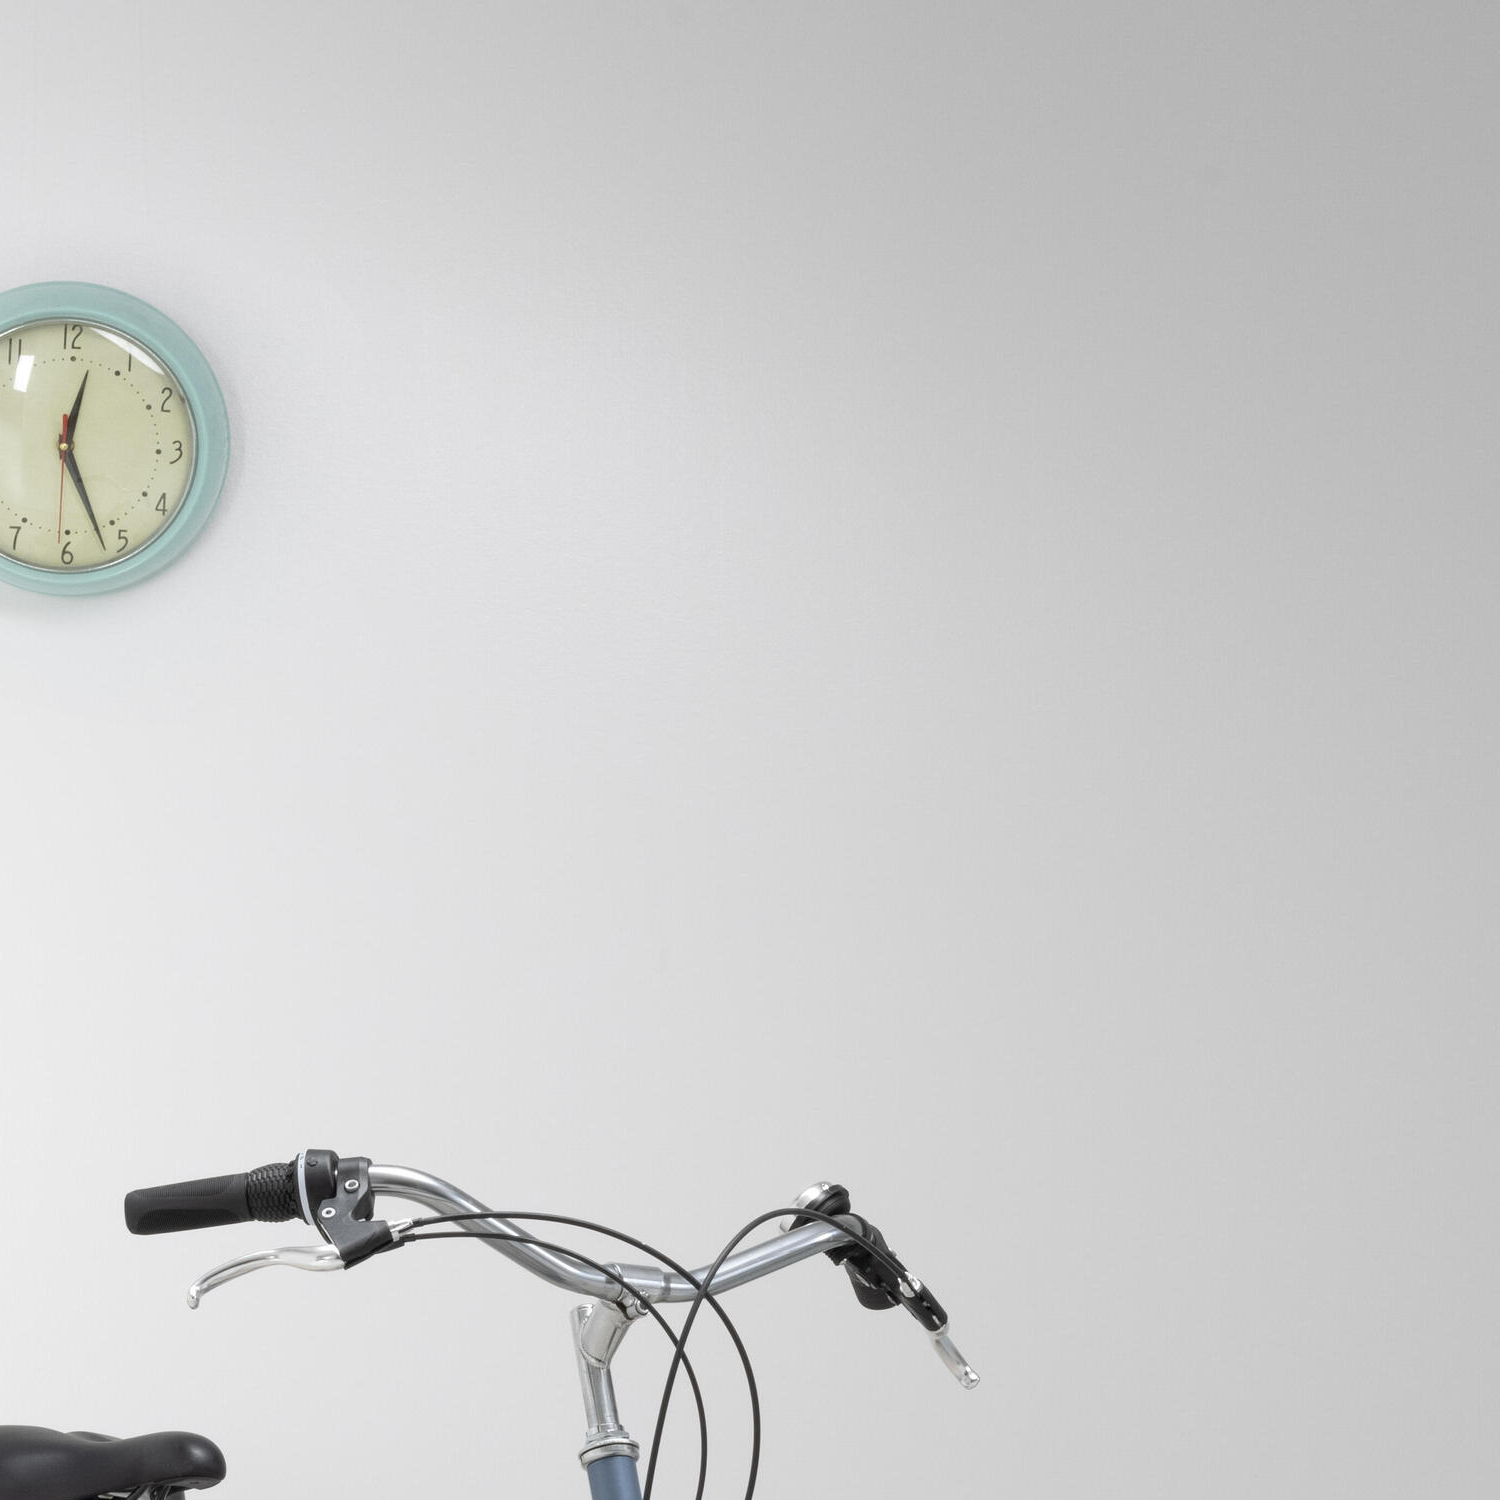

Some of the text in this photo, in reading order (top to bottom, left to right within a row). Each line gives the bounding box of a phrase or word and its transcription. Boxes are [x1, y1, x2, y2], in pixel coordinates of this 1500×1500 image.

[62, 323, 85, 350] 12
[7, 338, 23, 365] 11
[160, 387, 174, 413] 2
[169, 440, 184, 465] 3
[154, 492, 169, 517] 4
[8, 525, 22, 551] 7
[116, 528, 130, 554] 5
[60, 540, 75, 565] 6
